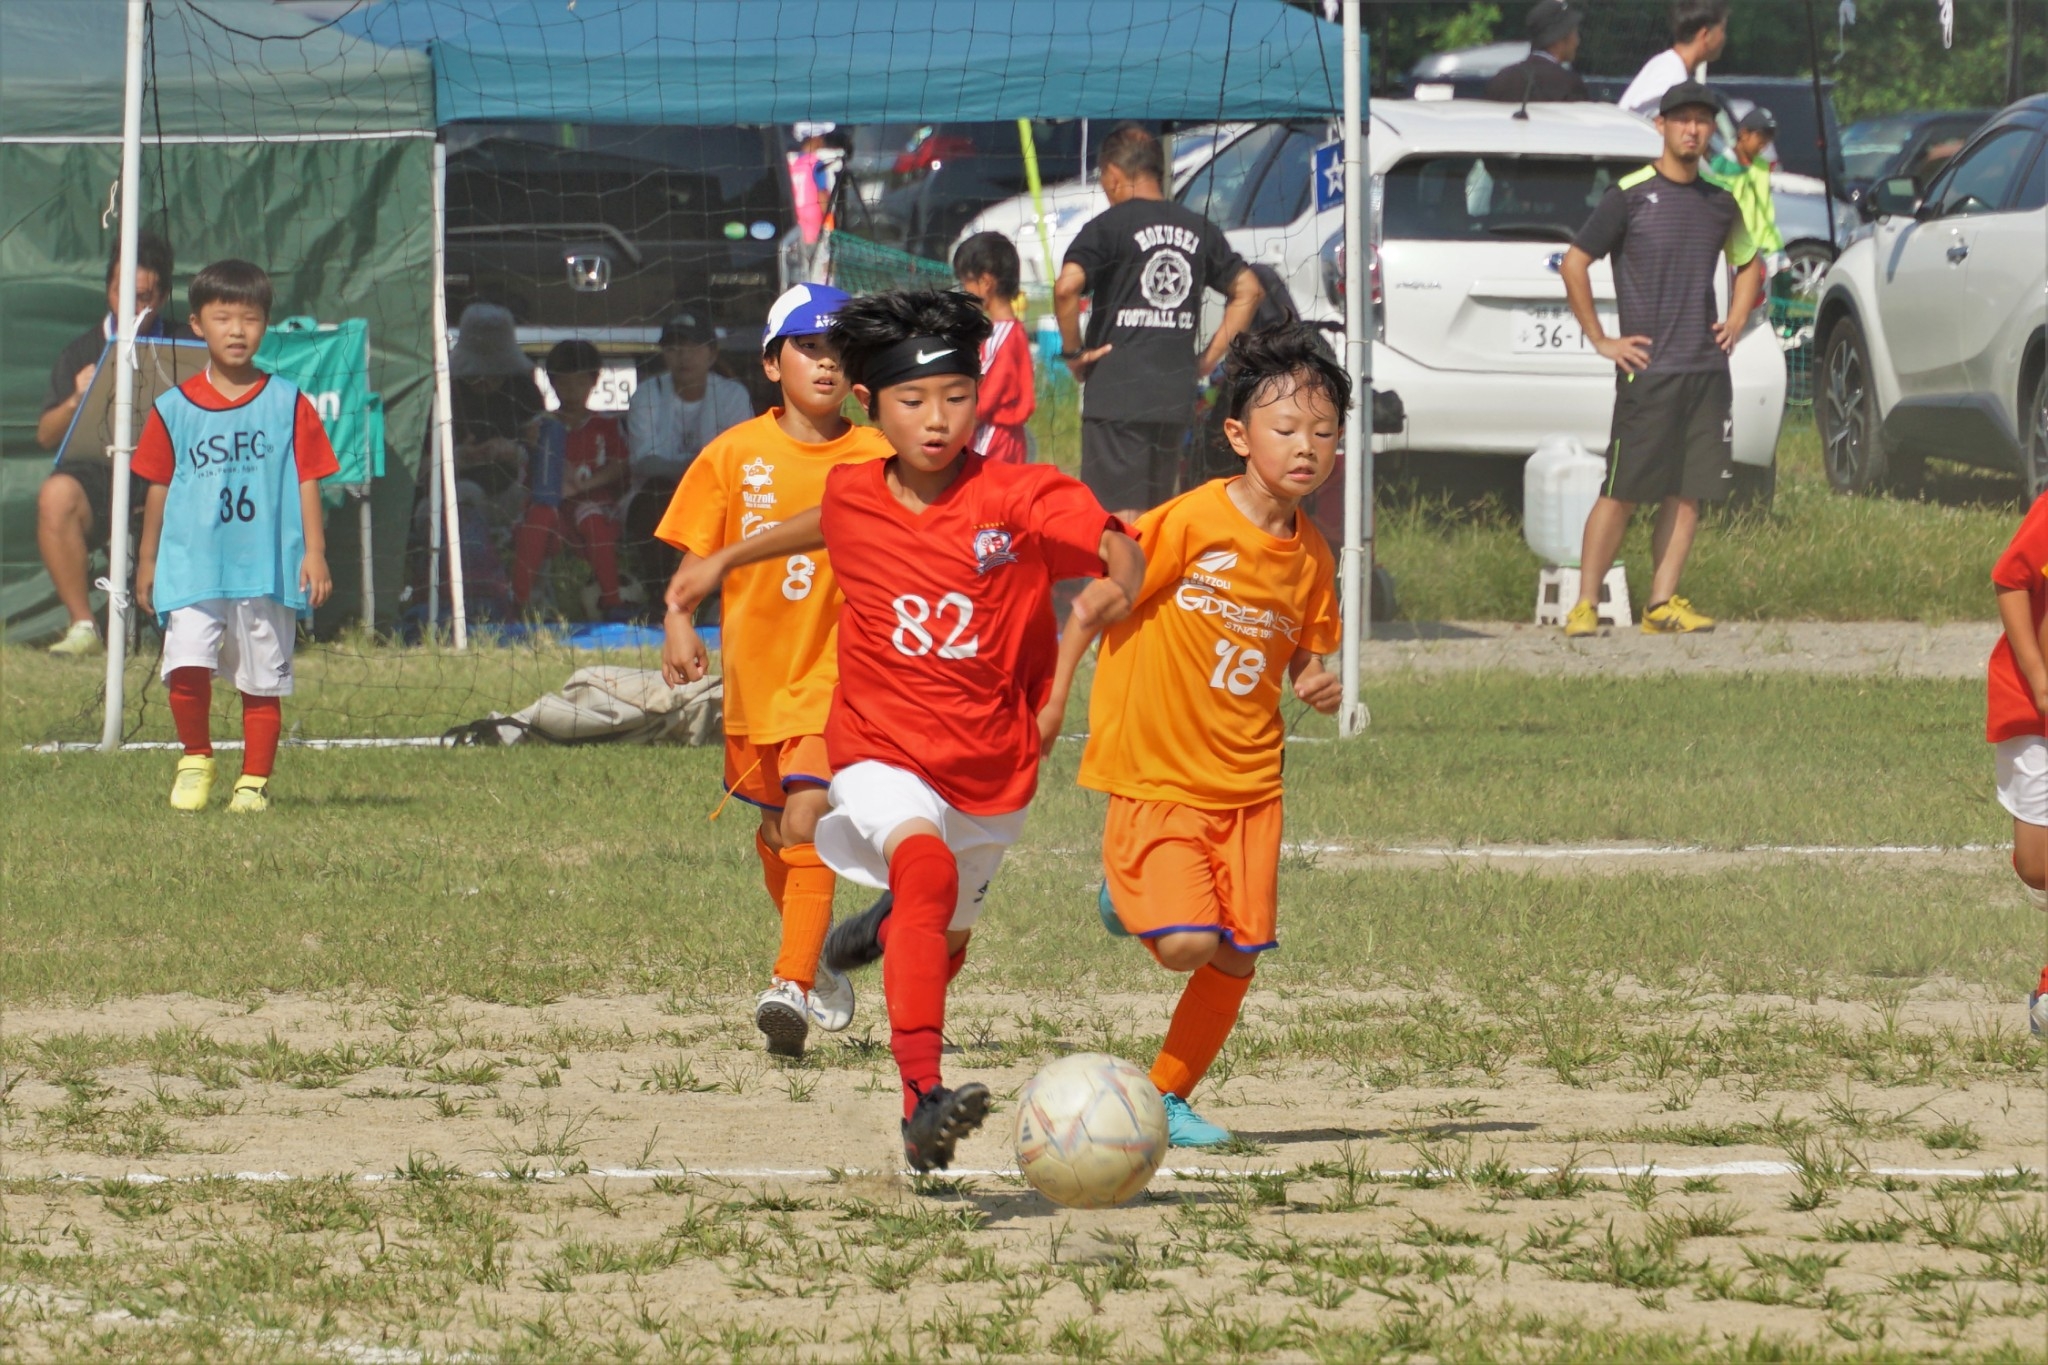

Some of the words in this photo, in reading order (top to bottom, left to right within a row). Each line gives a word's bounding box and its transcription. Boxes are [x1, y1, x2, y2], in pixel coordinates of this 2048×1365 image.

[1116, 308, 1176, 328] FOOTBALL
[1178, 311, 1195, 329] CL
[1534, 323, 1586, 349] 36-1
[219, 485, 256, 523] 36
[782, 554, 815, 601] 8
[1192, 572, 1232, 590] RAZZOLI
[891, 592, 979, 660] 82
[1224, 621, 1259, 638] SINCE
[1209, 638, 1266, 696] 18
